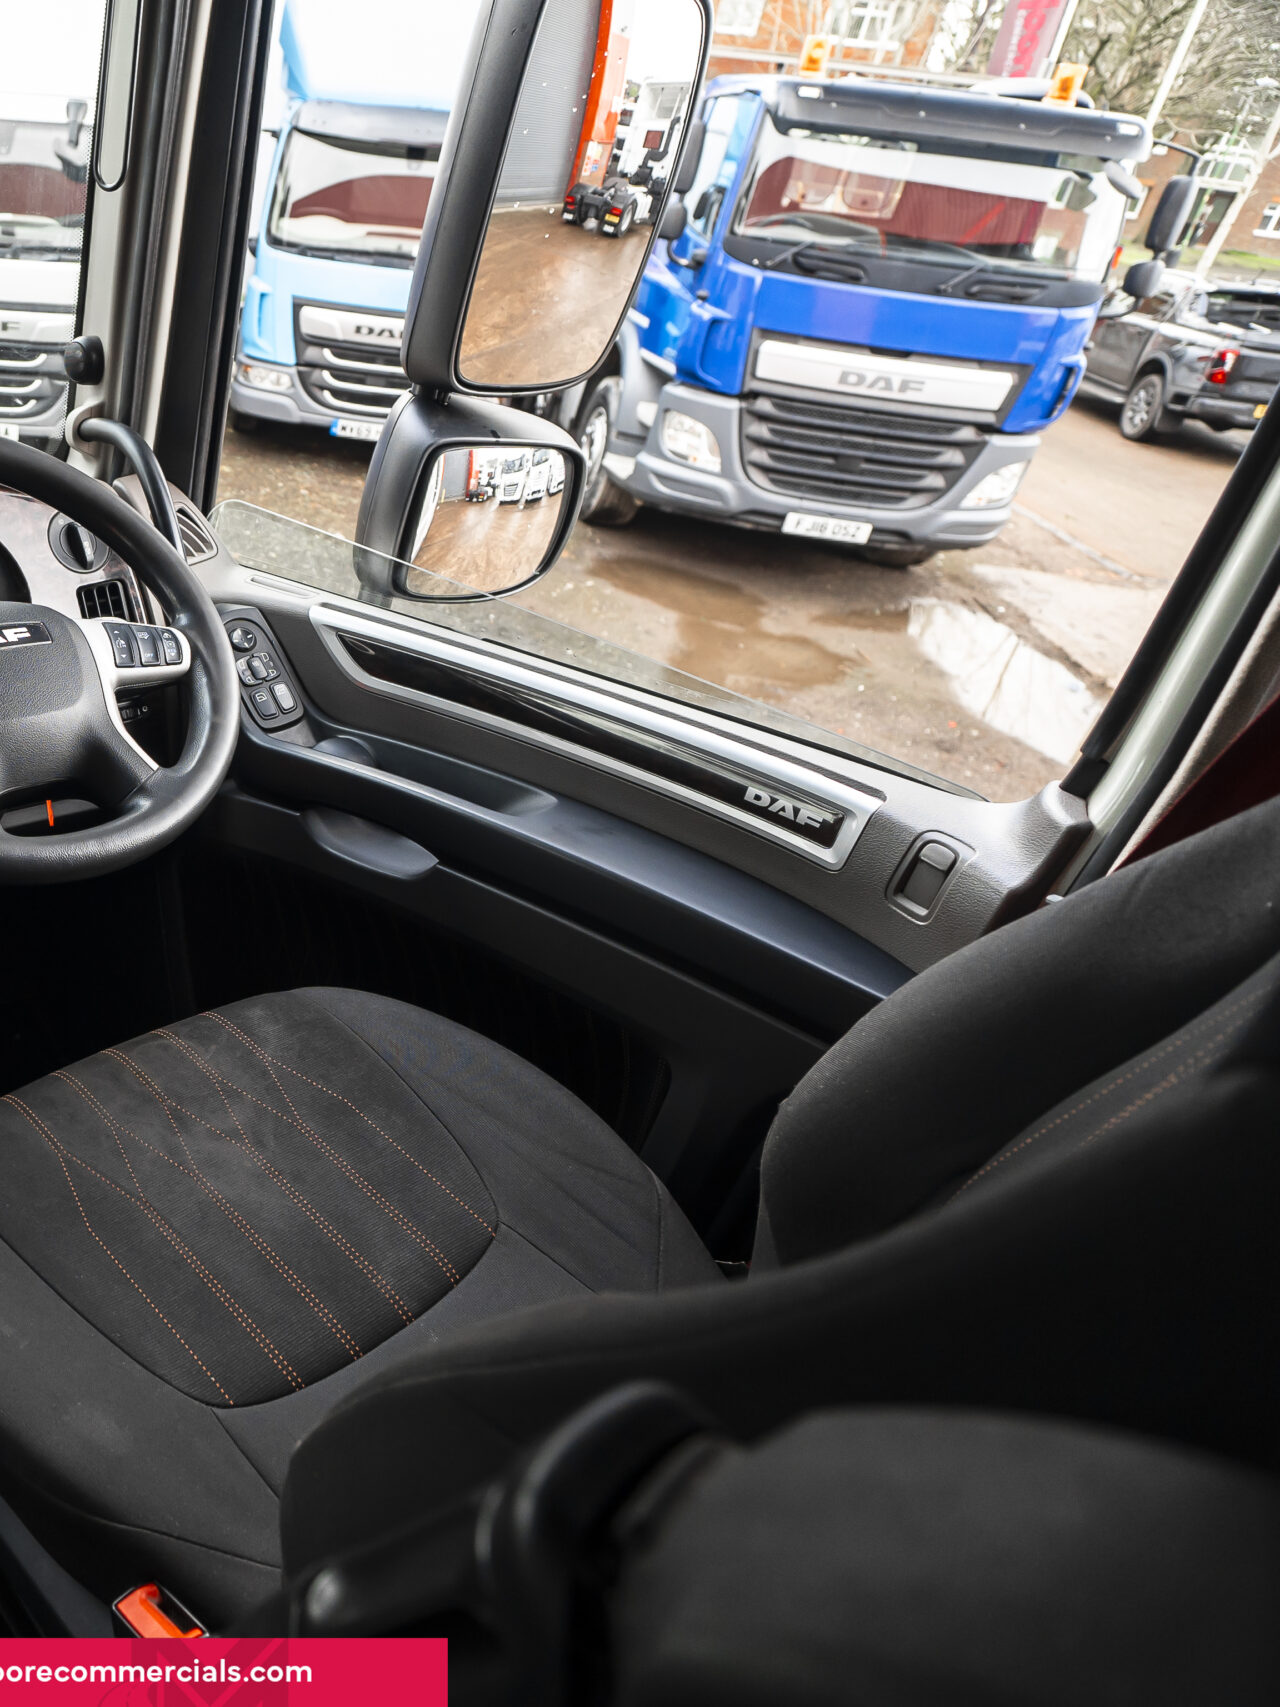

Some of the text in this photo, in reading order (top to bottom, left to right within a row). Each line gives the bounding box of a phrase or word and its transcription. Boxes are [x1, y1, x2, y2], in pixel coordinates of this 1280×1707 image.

[354, 325, 404, 338] DA
[838, 370, 925, 392] DAF
[744, 786, 824, 828] DAF
